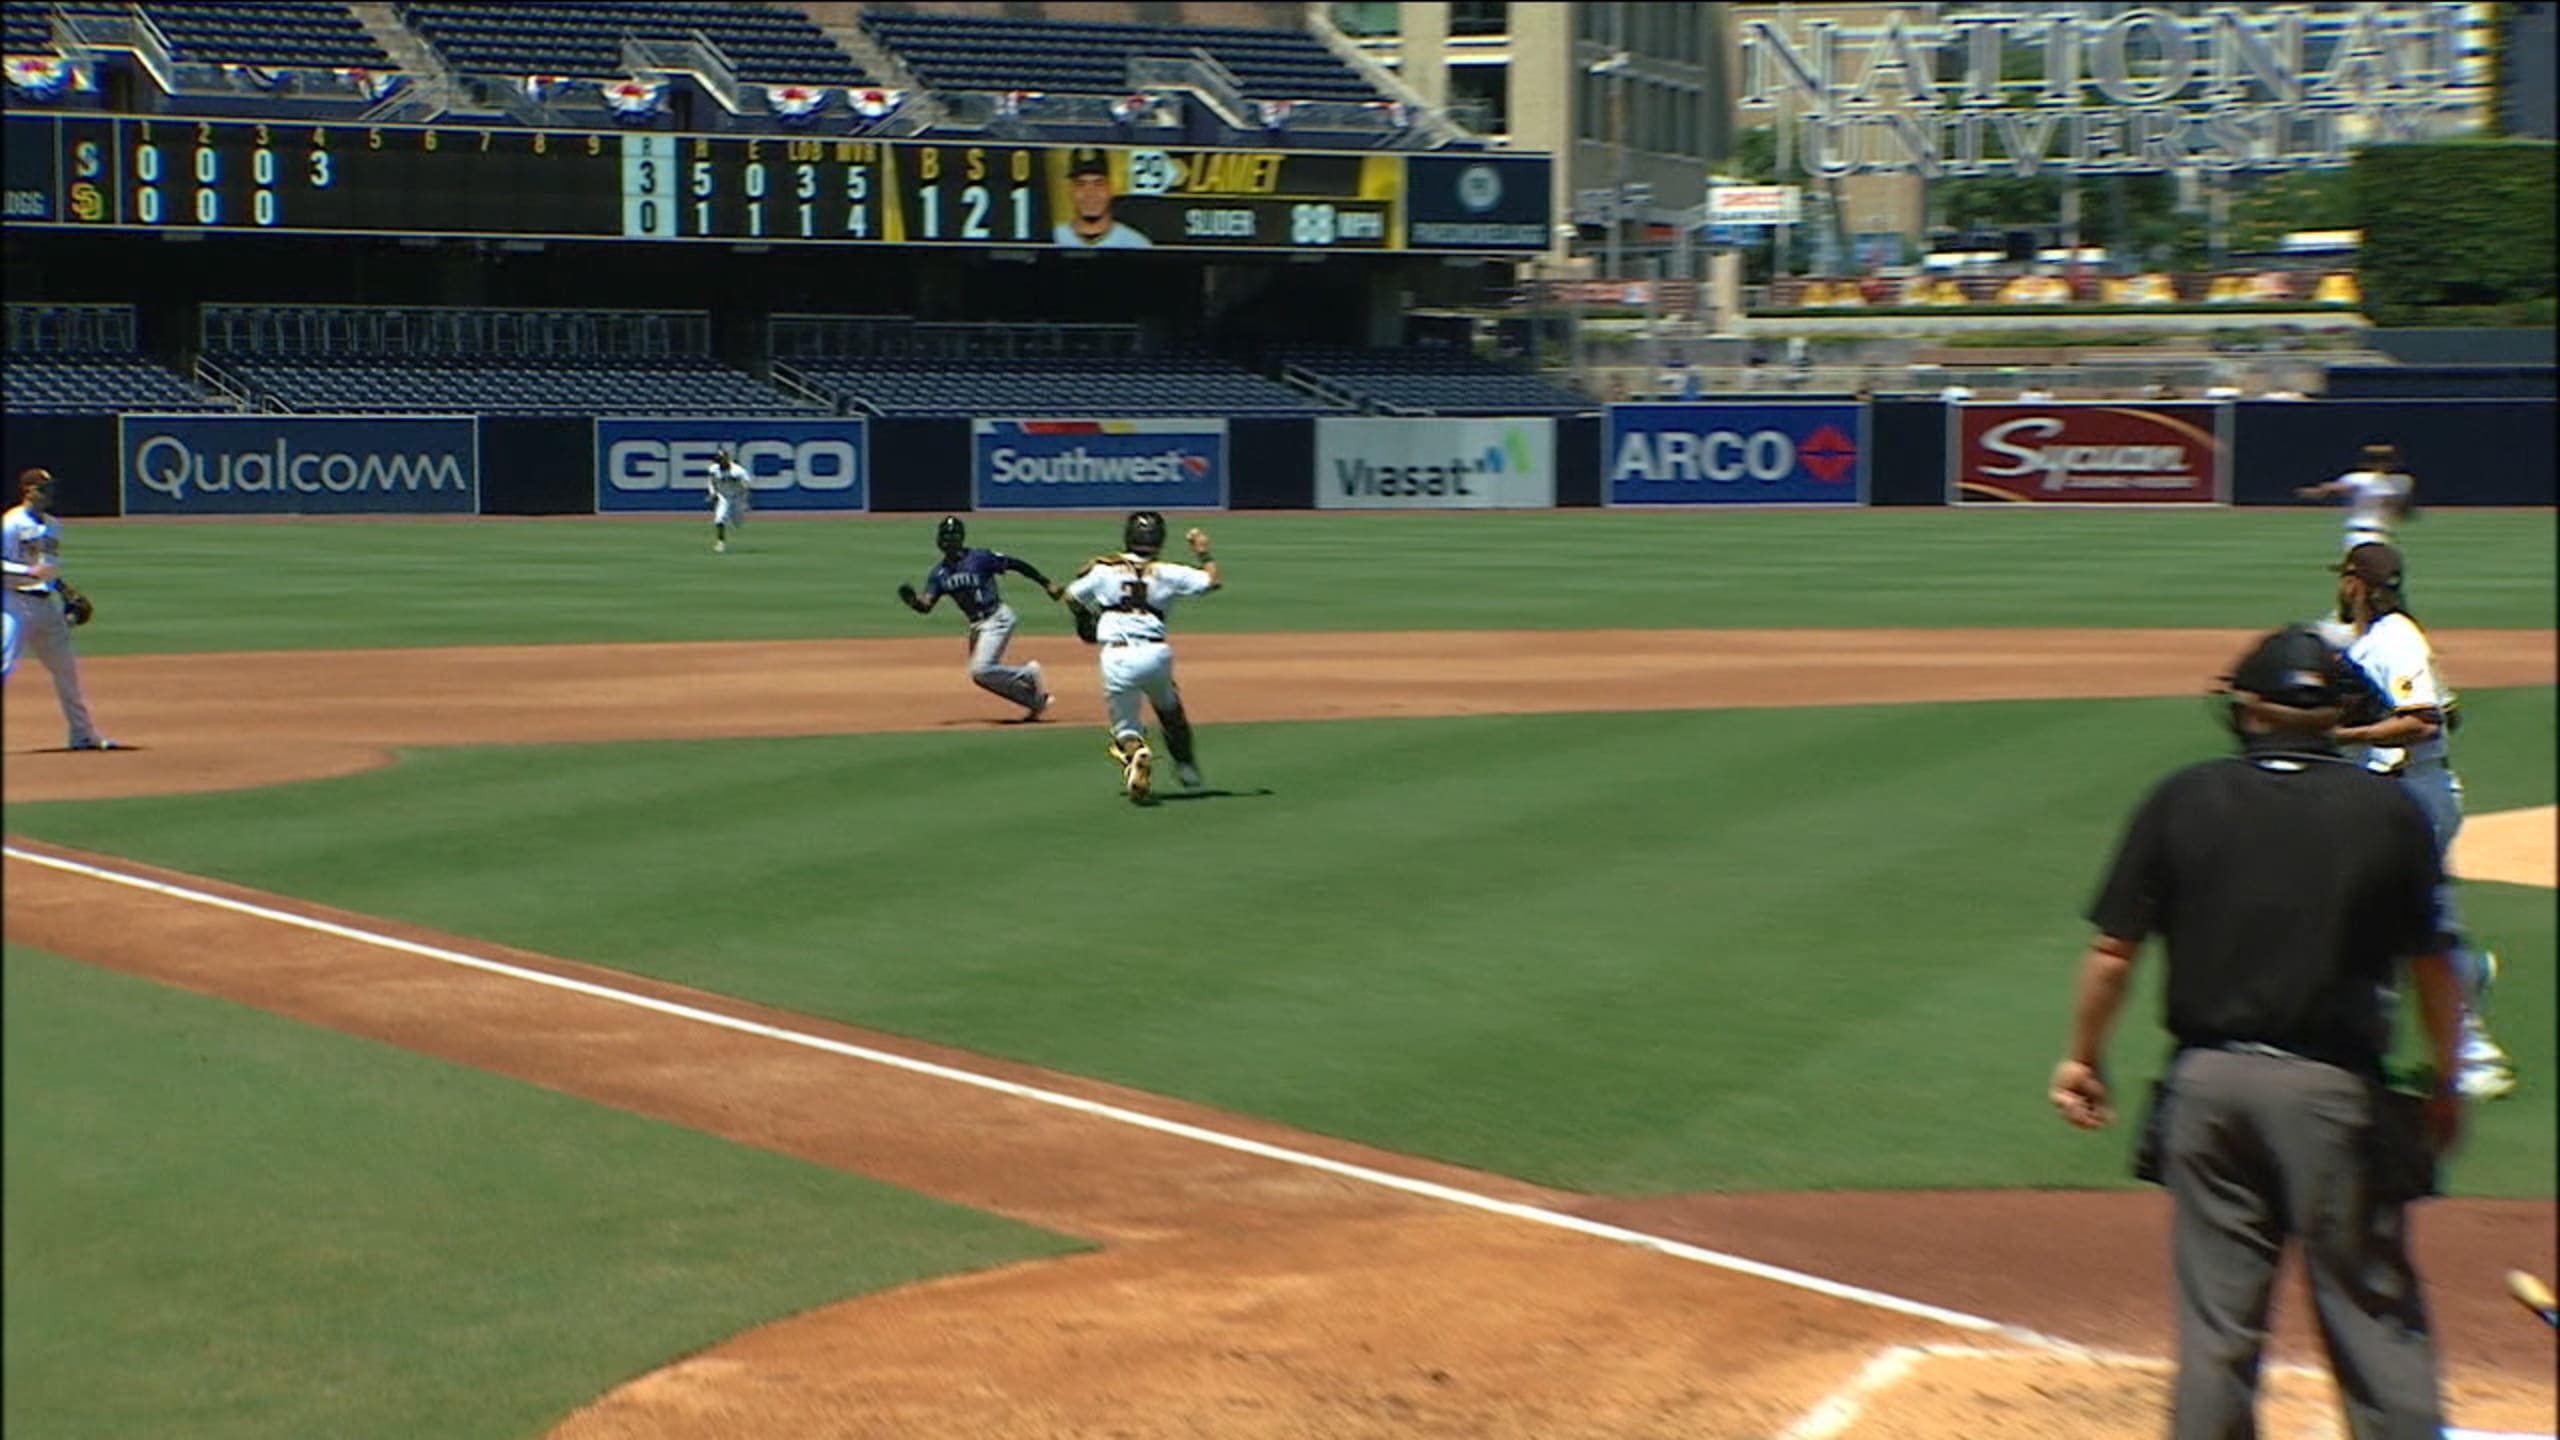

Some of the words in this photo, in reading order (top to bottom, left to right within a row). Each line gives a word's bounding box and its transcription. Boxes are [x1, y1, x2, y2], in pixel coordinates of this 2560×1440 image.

[141, 121, 152, 142] 1
[199, 123, 212, 144] 2
[256, 125, 270, 145] 3
[313, 126, 326, 147] 4
[369, 129, 382, 149] 5
[424, 130, 437, 151] 6
[479, 132, 491, 152] 7
[534, 133, 546, 154] 8
[587, 135, 600, 155] 9
[920, 147, 940, 181] B
[966, 149, 986, 181] S
[137, 145, 159, 182] 0
[196, 147, 217, 184] 0
[254, 149, 274, 185] 0
[310, 151, 330, 186] 3
[640, 161, 656, 194] 3
[692, 162, 712, 197] 5
[745, 163, 765, 197] 0
[797, 164, 816, 199] 3
[848, 166, 867, 200] 5
[137, 186, 159, 223] 0
[196, 188, 217, 225] 0
[254, 189, 274, 226] 0
[640, 201, 656, 233] 0
[696, 202, 710, 235] 1
[748, 203, 761, 236] 1
[800, 203, 812, 237] 1
[848, 204, 867, 238] 4
[918, 185, 941, 238] 1
[961, 186, 991, 239] 2
[1010, 187, 1030, 239] 1
[609, 439, 856, 491] GECO
[991, 447, 1184, 485] Southwest
[1334, 457, 1474, 497] Viasat
[1612, 429, 1794, 482] ARCO
